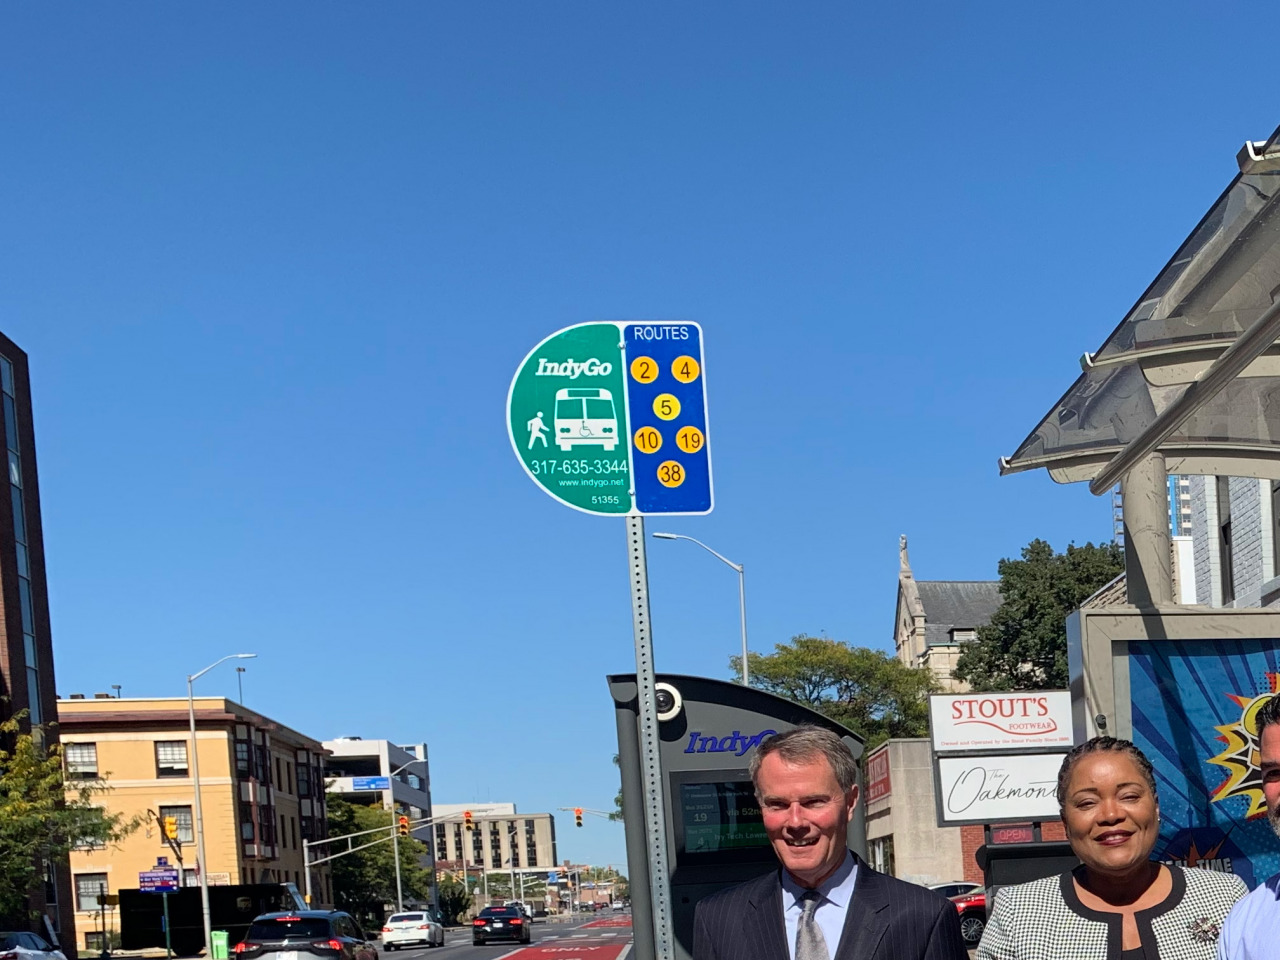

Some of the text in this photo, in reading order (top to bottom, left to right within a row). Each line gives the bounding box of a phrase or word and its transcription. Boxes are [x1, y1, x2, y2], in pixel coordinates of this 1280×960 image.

[634, 326, 689, 340] ROUTES
[535, 358, 613, 379] IndyGo
[639, 362, 691, 379] 2 4
[661, 400, 672, 416] 5
[638, 432, 700, 449] 10 19
[531, 460, 628, 474] 317-635-3344
[661, 465, 681, 482] 38
[558, 478, 624, 487] www.indygo.net
[591, 496, 619, 504] 51355
[951, 697, 1049, 719] STOUT'S
[684, 730, 778, 756] Indy
[987, 769, 1005, 780] The
[1000, 829, 1026, 839] OPEN
